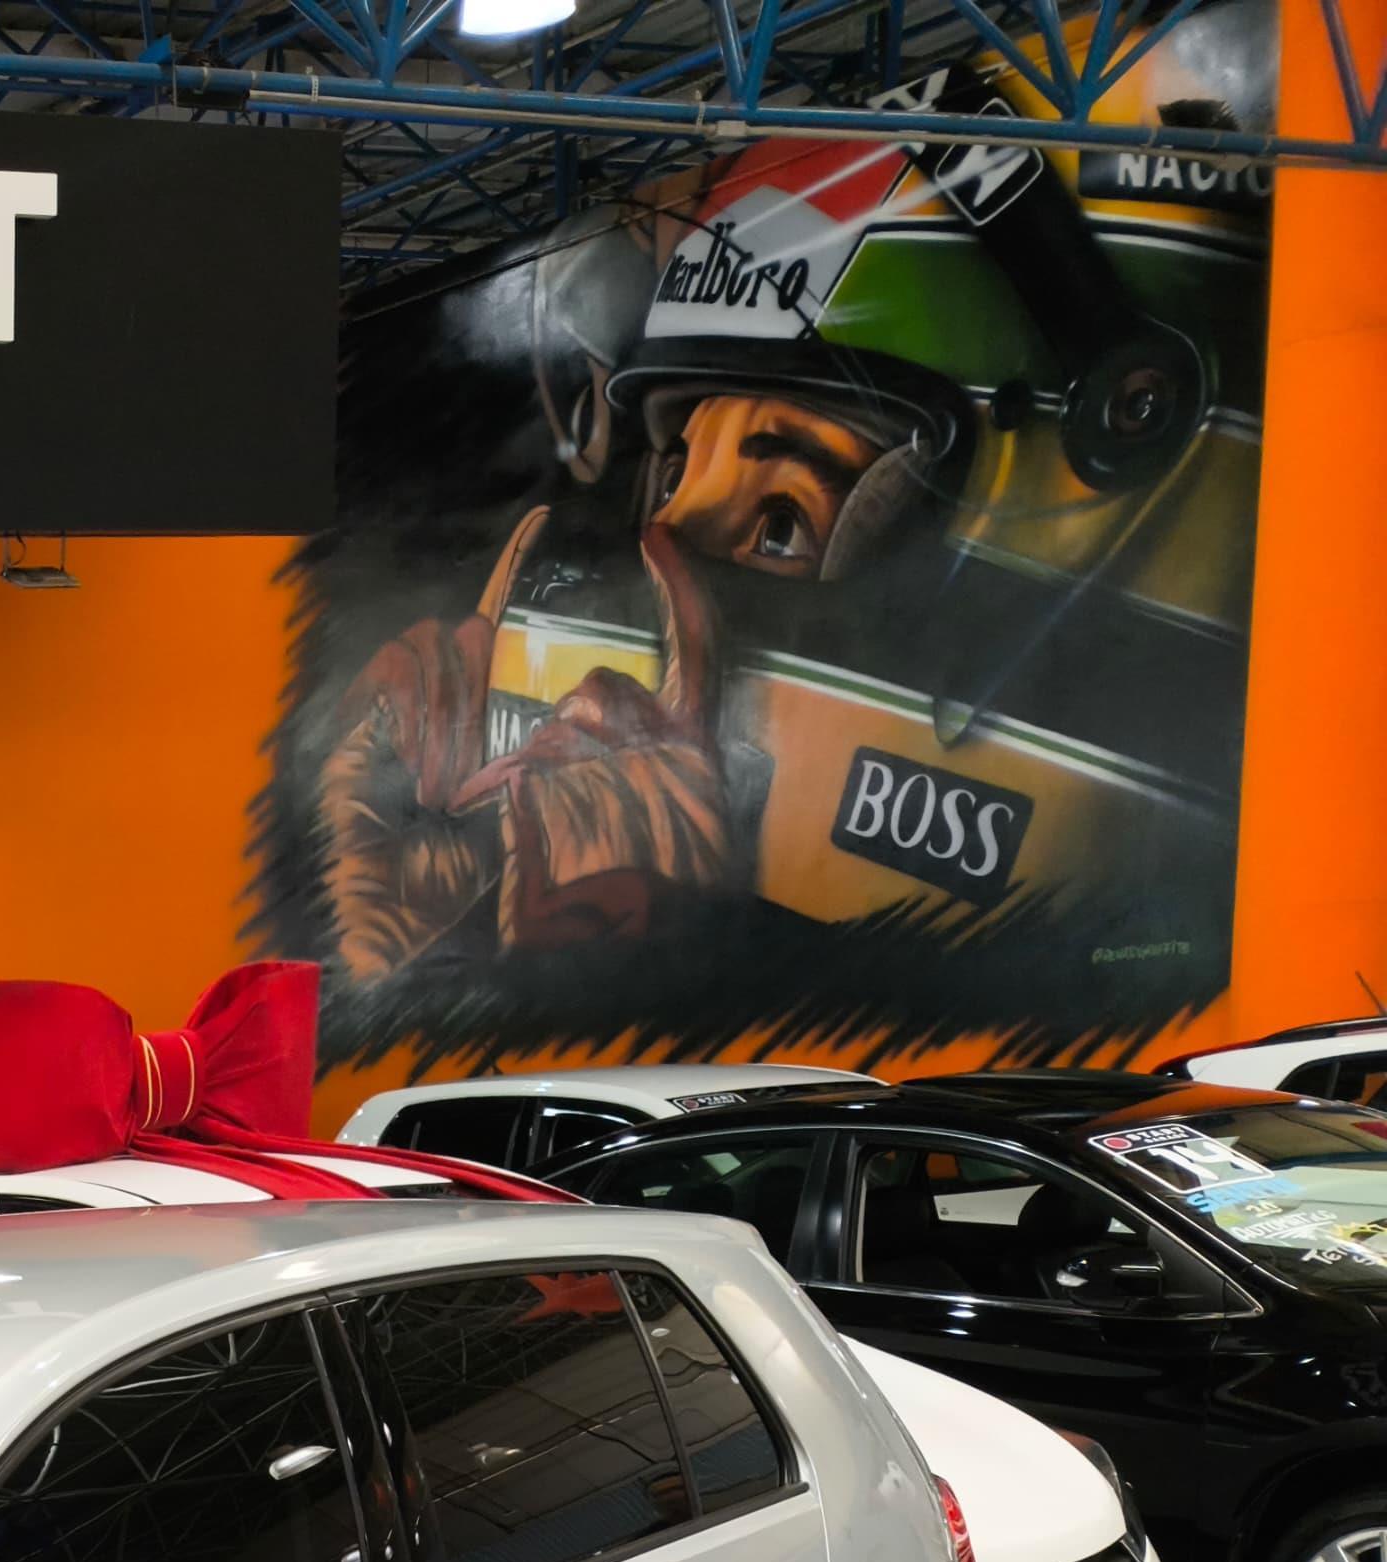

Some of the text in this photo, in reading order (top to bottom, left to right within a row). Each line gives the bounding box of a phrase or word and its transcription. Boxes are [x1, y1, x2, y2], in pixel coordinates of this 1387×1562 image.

[656, 221, 809, 310] Marlboro
[845, 760, 1014, 876] BOSS
[1147, 1141, 1263, 1181] 14
